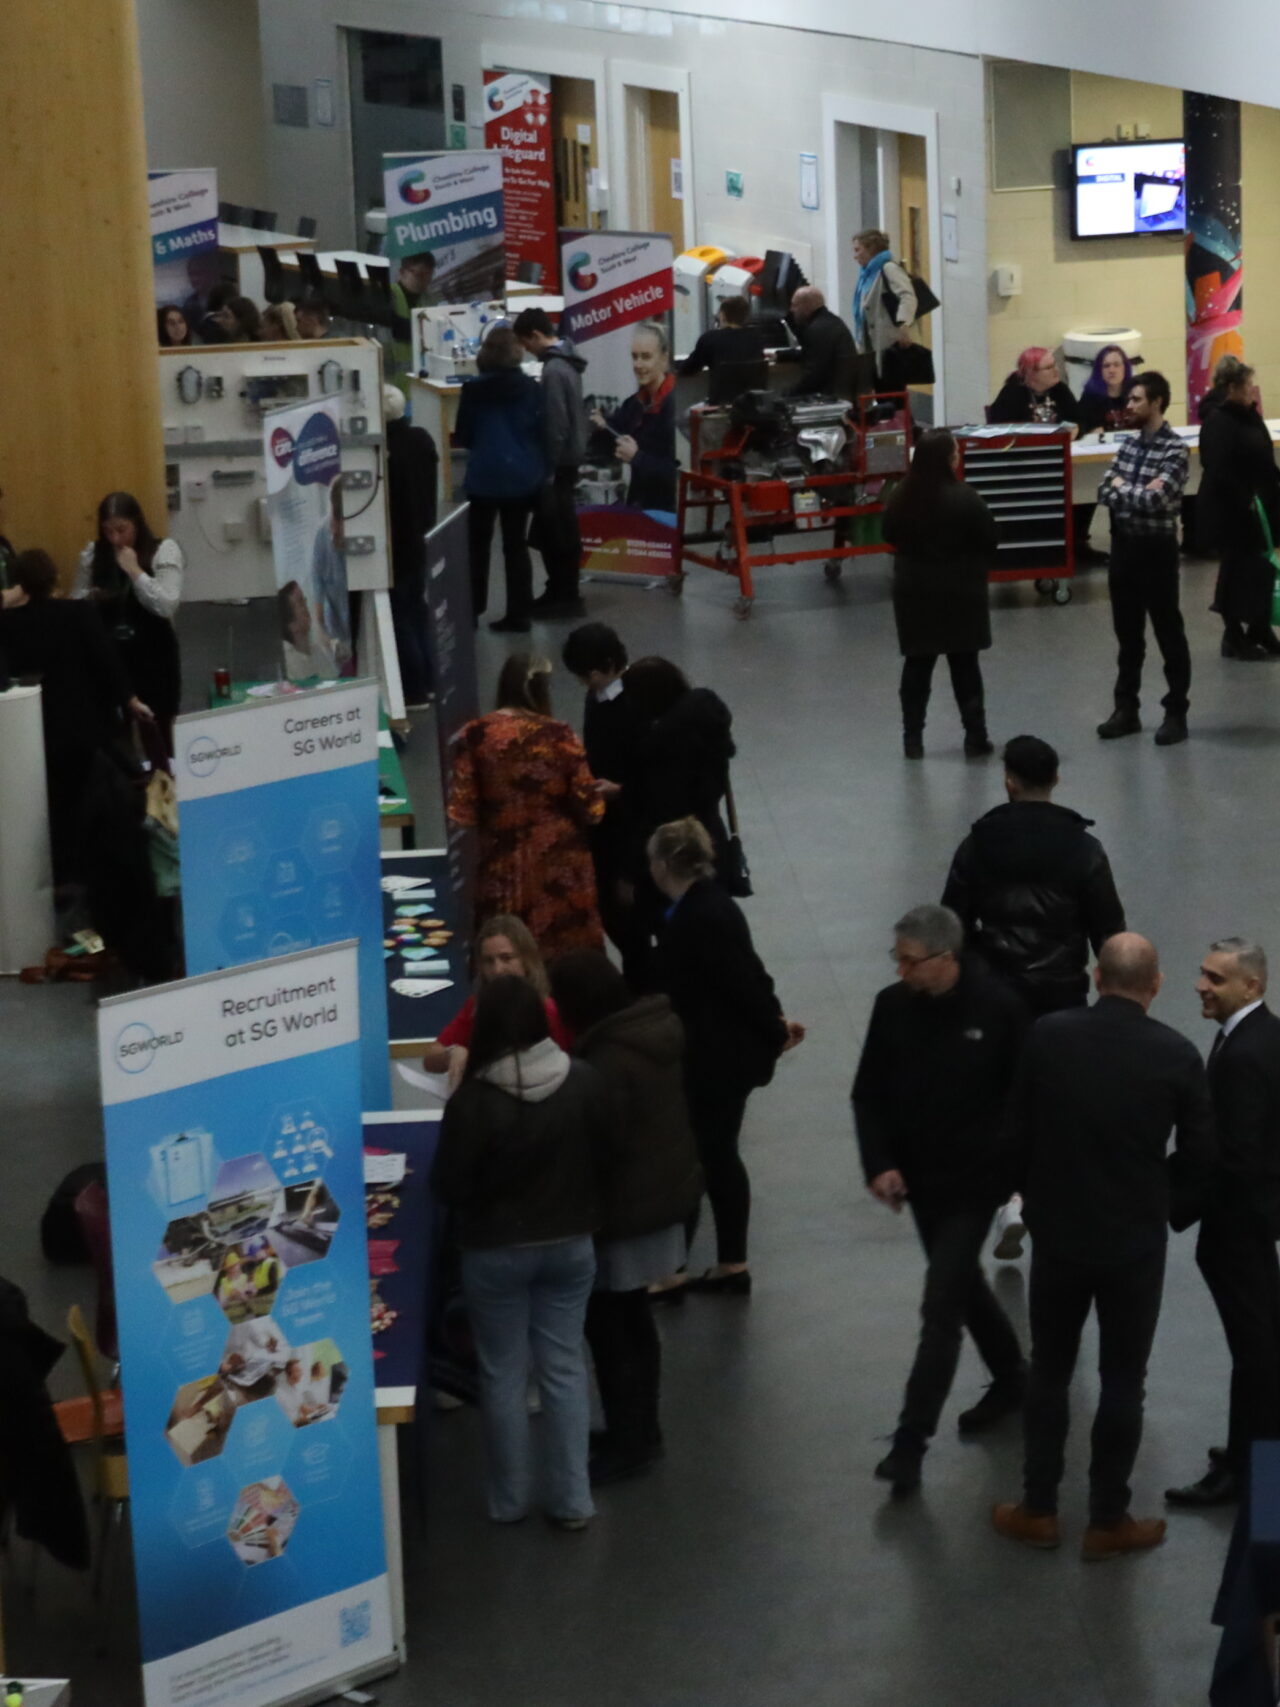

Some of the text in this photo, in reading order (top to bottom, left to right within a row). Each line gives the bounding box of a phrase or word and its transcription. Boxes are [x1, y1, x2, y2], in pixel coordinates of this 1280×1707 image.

[169, 229, 216, 251] Maths
[395, 206, 498, 246] Plumbing
[570, 286, 665, 332] Motor Vehicle
[284, 711, 343, 734] Careers
[346, 707, 362, 722] at
[293, 730, 362, 757] SG World
[119, 976, 337, 1057] SGWORLD Recruitment
[225, 1004, 338, 1048] at SG World
